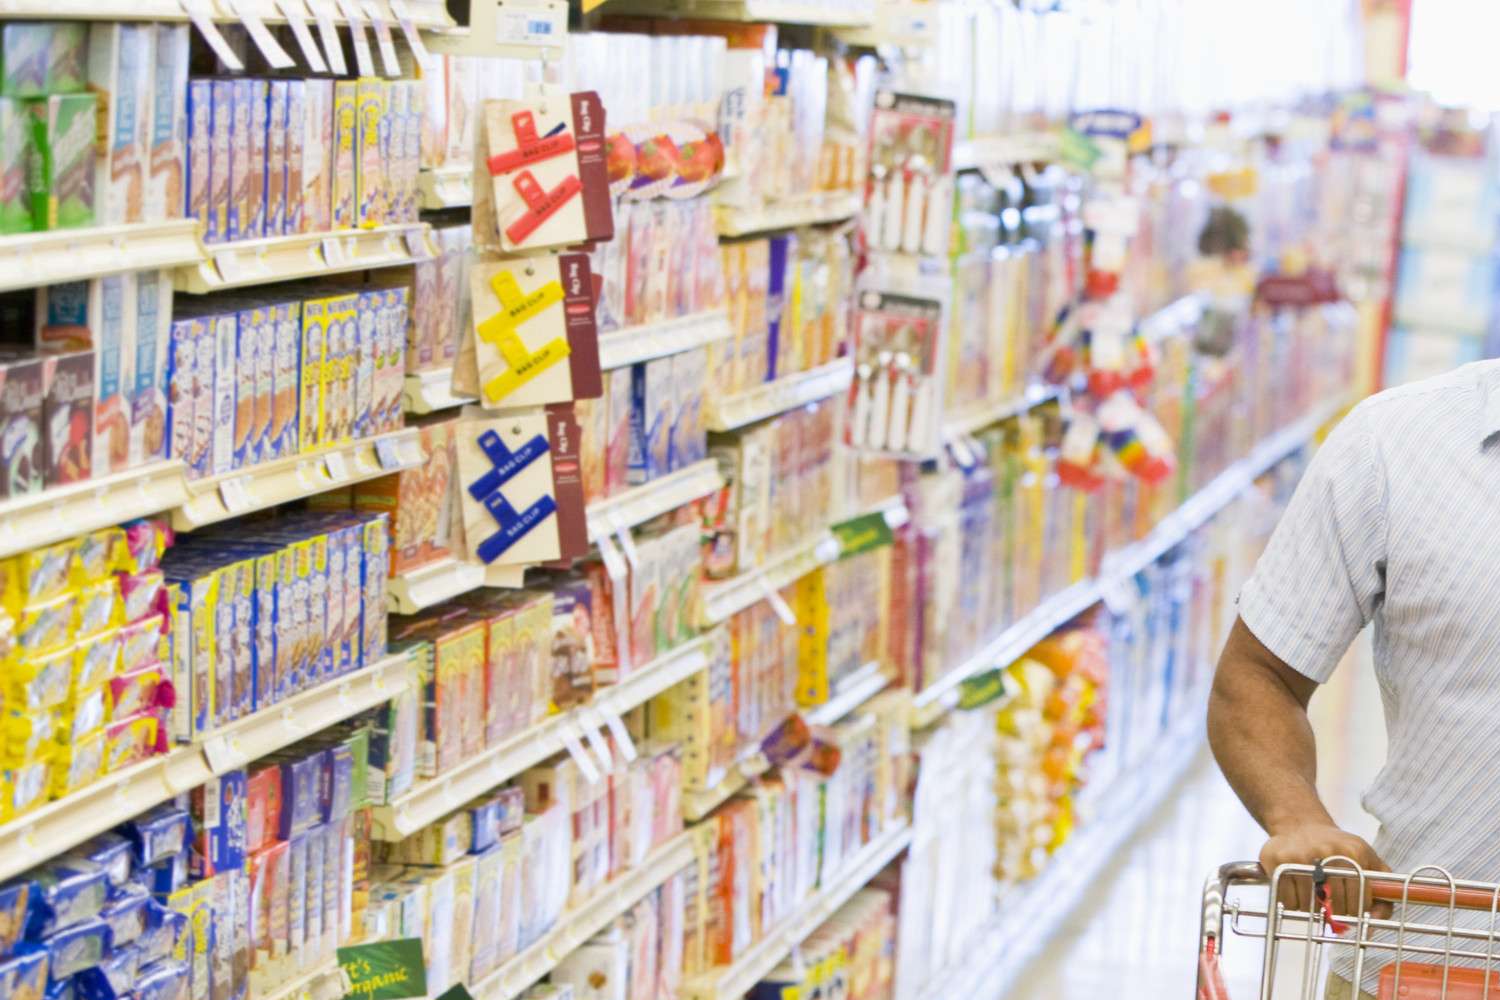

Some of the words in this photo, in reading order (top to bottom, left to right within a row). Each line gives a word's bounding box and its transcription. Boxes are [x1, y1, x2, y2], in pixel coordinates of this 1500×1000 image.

[498, 460, 516, 475] BAG
[514, 447, 532, 463] CLIP
[507, 521, 524, 537] BAG
[522, 507, 540, 524] CLIP
